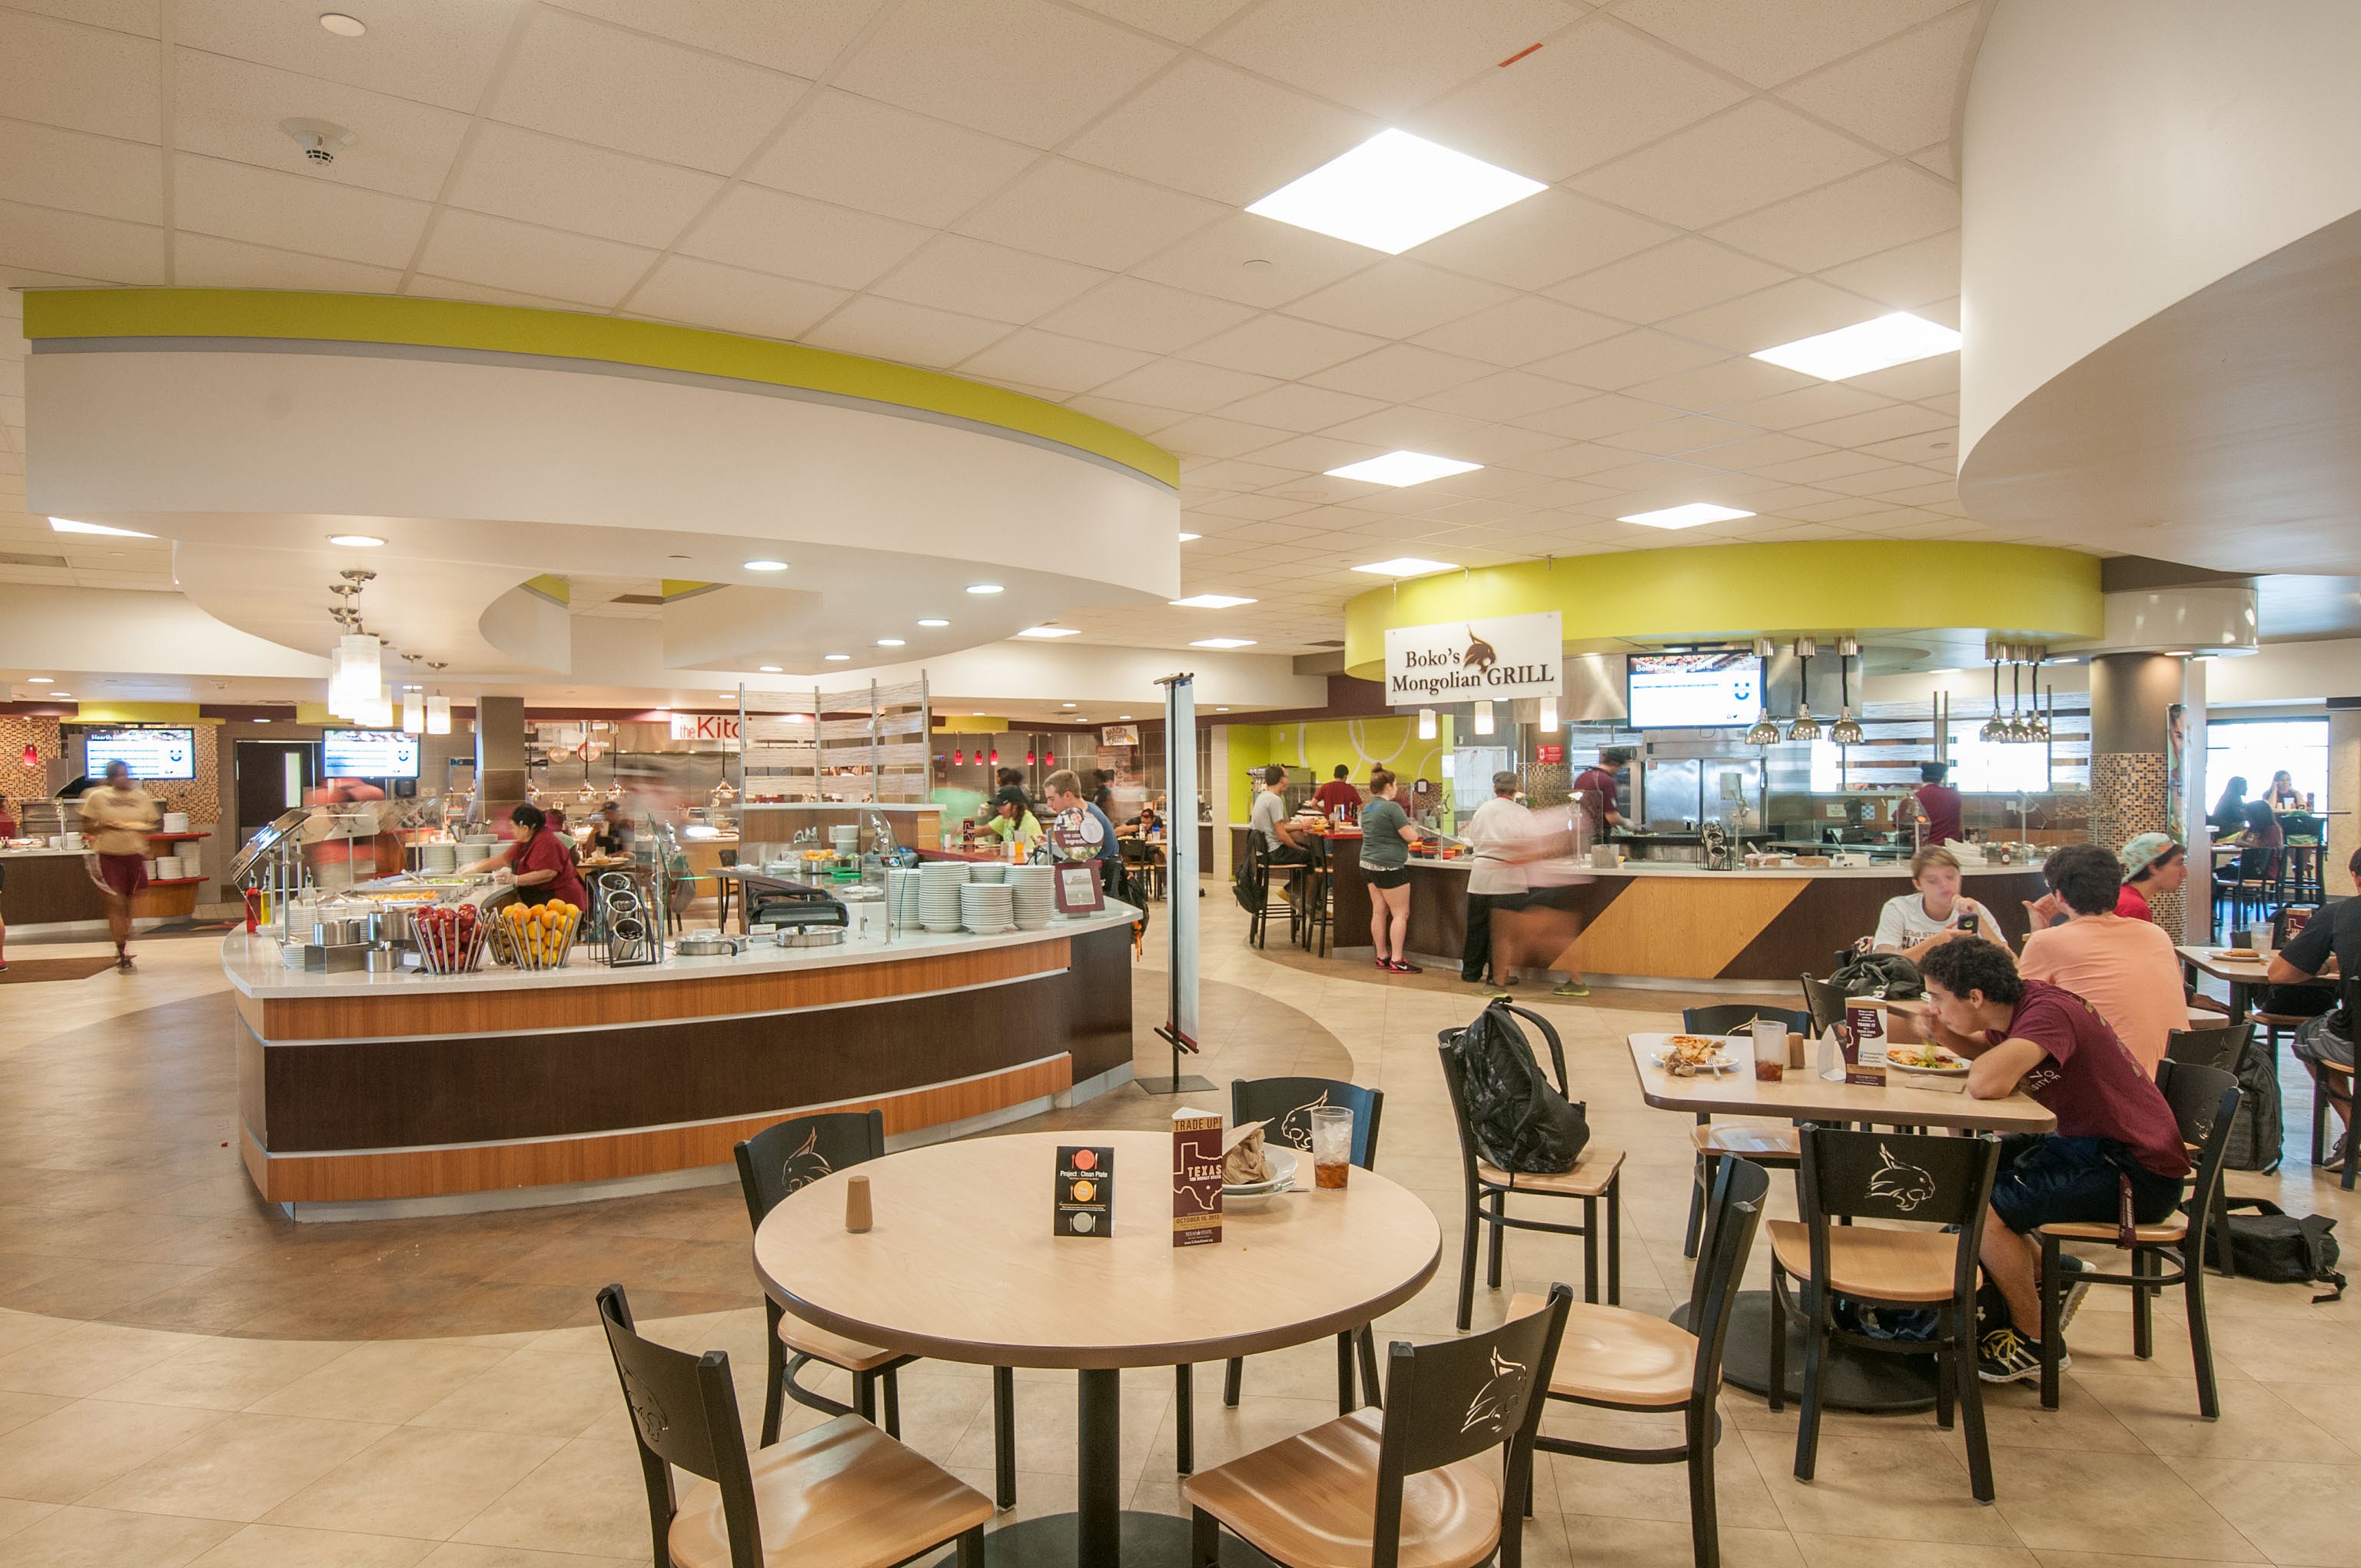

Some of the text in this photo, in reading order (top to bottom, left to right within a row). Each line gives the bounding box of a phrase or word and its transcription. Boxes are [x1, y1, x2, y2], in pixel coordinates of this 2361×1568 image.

[1406, 647, 1460, 668] Boko's
[1392, 663, 1554, 696] Mongolian GRILL
[679, 725, 695, 739] the
[1174, 1118, 1222, 1131] TRADE UP!
[1060, 1170, 1078, 1178] Project
[1187, 1164, 1222, 1178] TEXAS
